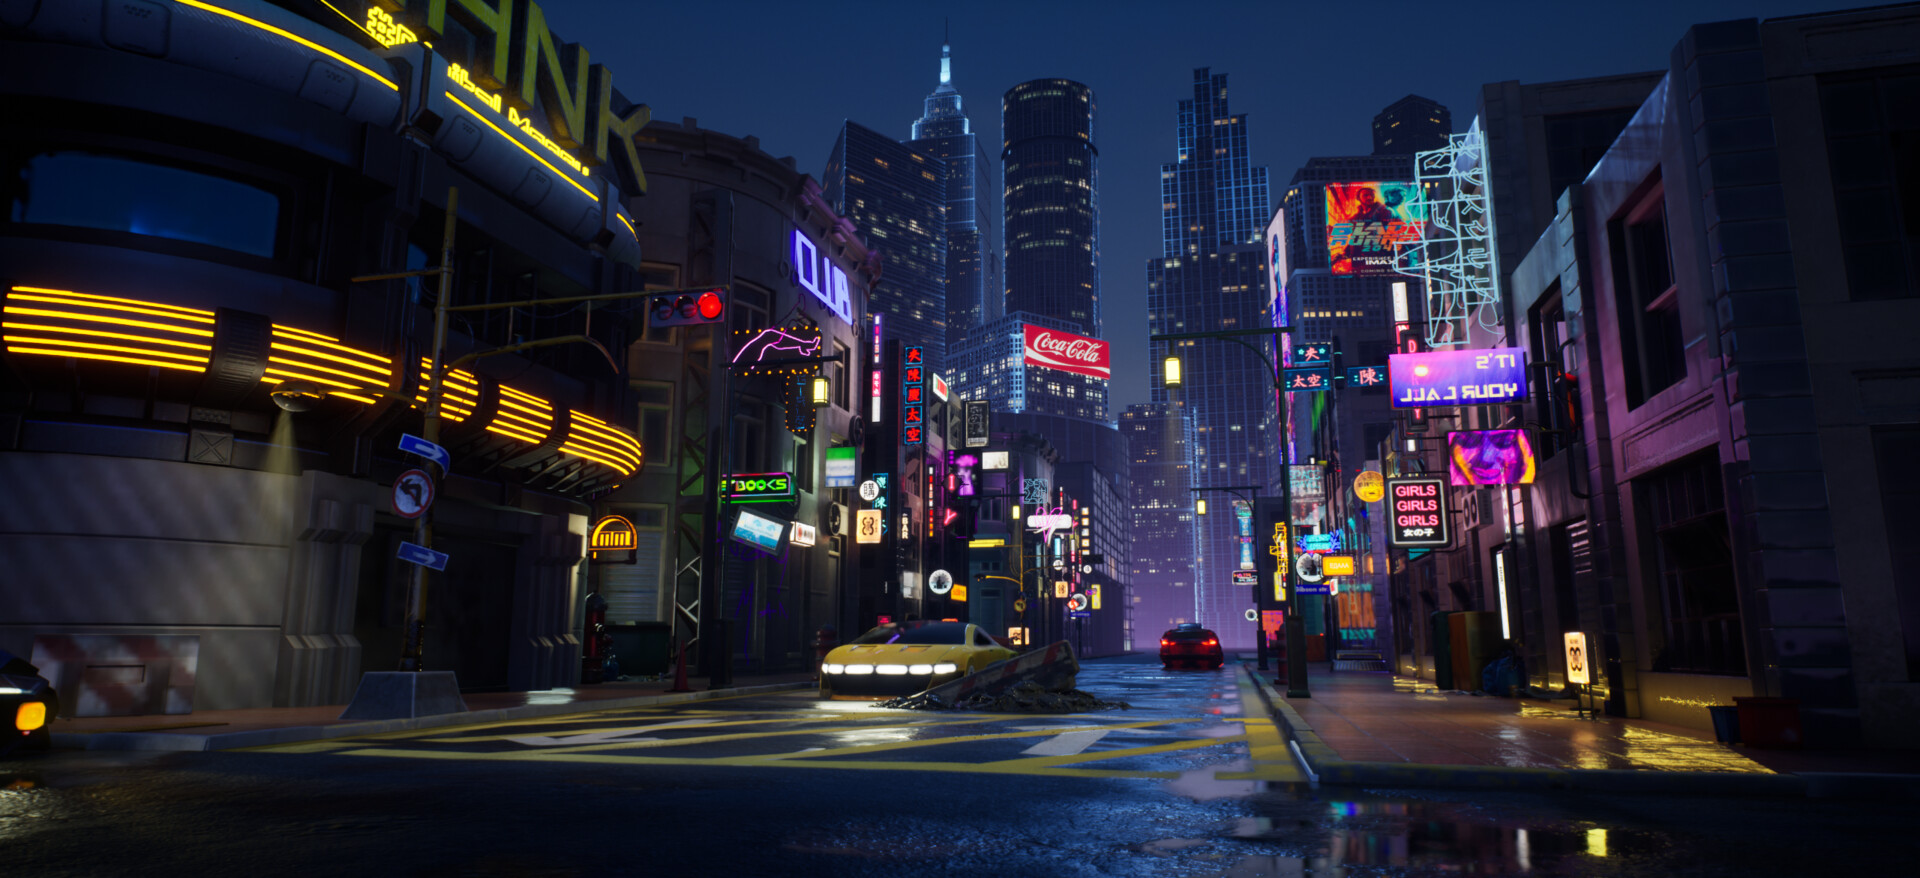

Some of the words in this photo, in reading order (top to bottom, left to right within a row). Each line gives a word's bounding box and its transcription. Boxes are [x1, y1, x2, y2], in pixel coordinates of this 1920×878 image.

[1395, 485, 1437, 497] GIRLS
[1396, 500, 1438, 512] GIRLS
[1397, 515, 1439, 527] GIRLS
[901, 517, 909, 539] BAR
[1403, 528, 1434, 537] 女の子
